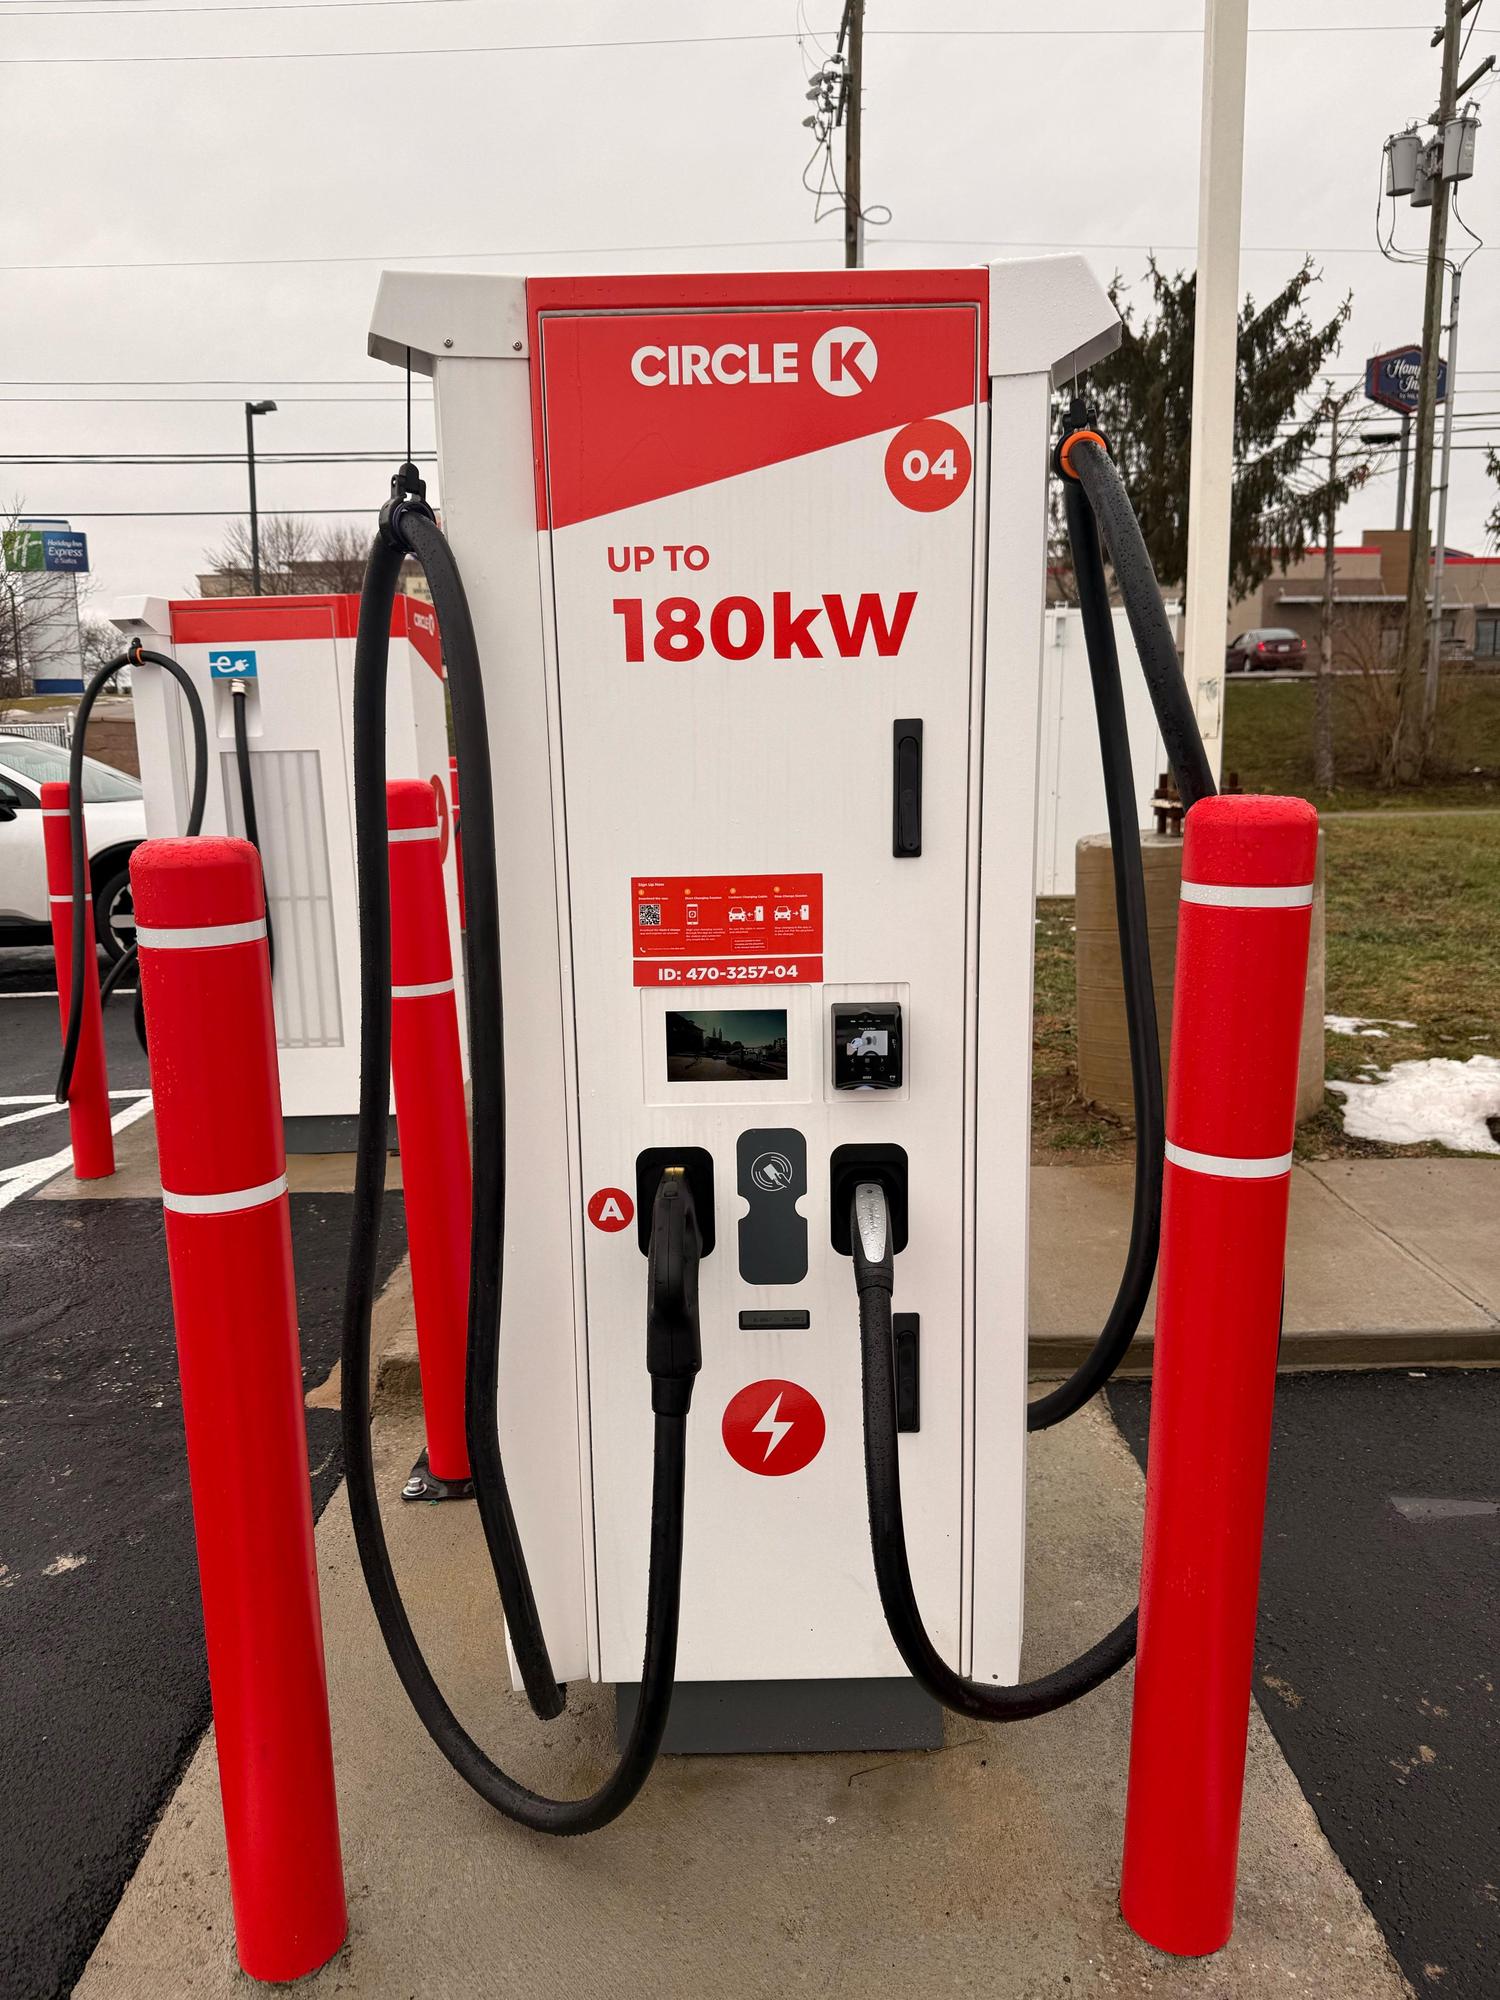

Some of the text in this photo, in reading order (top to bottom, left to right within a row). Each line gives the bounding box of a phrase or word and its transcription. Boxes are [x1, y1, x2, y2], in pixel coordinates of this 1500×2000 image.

[630, 331, 877, 395] CIRCLE K
[902, 449, 957, 481] 04
[47, 539, 72, 547] Holiday
[48, 547, 83, 557] Express
[607, 545, 710, 572] UP TO
[612, 591, 918, 663] 180kW
[658, 964, 799, 981] ID: 470-3257-04
[598, 1197, 625, 1221] A
